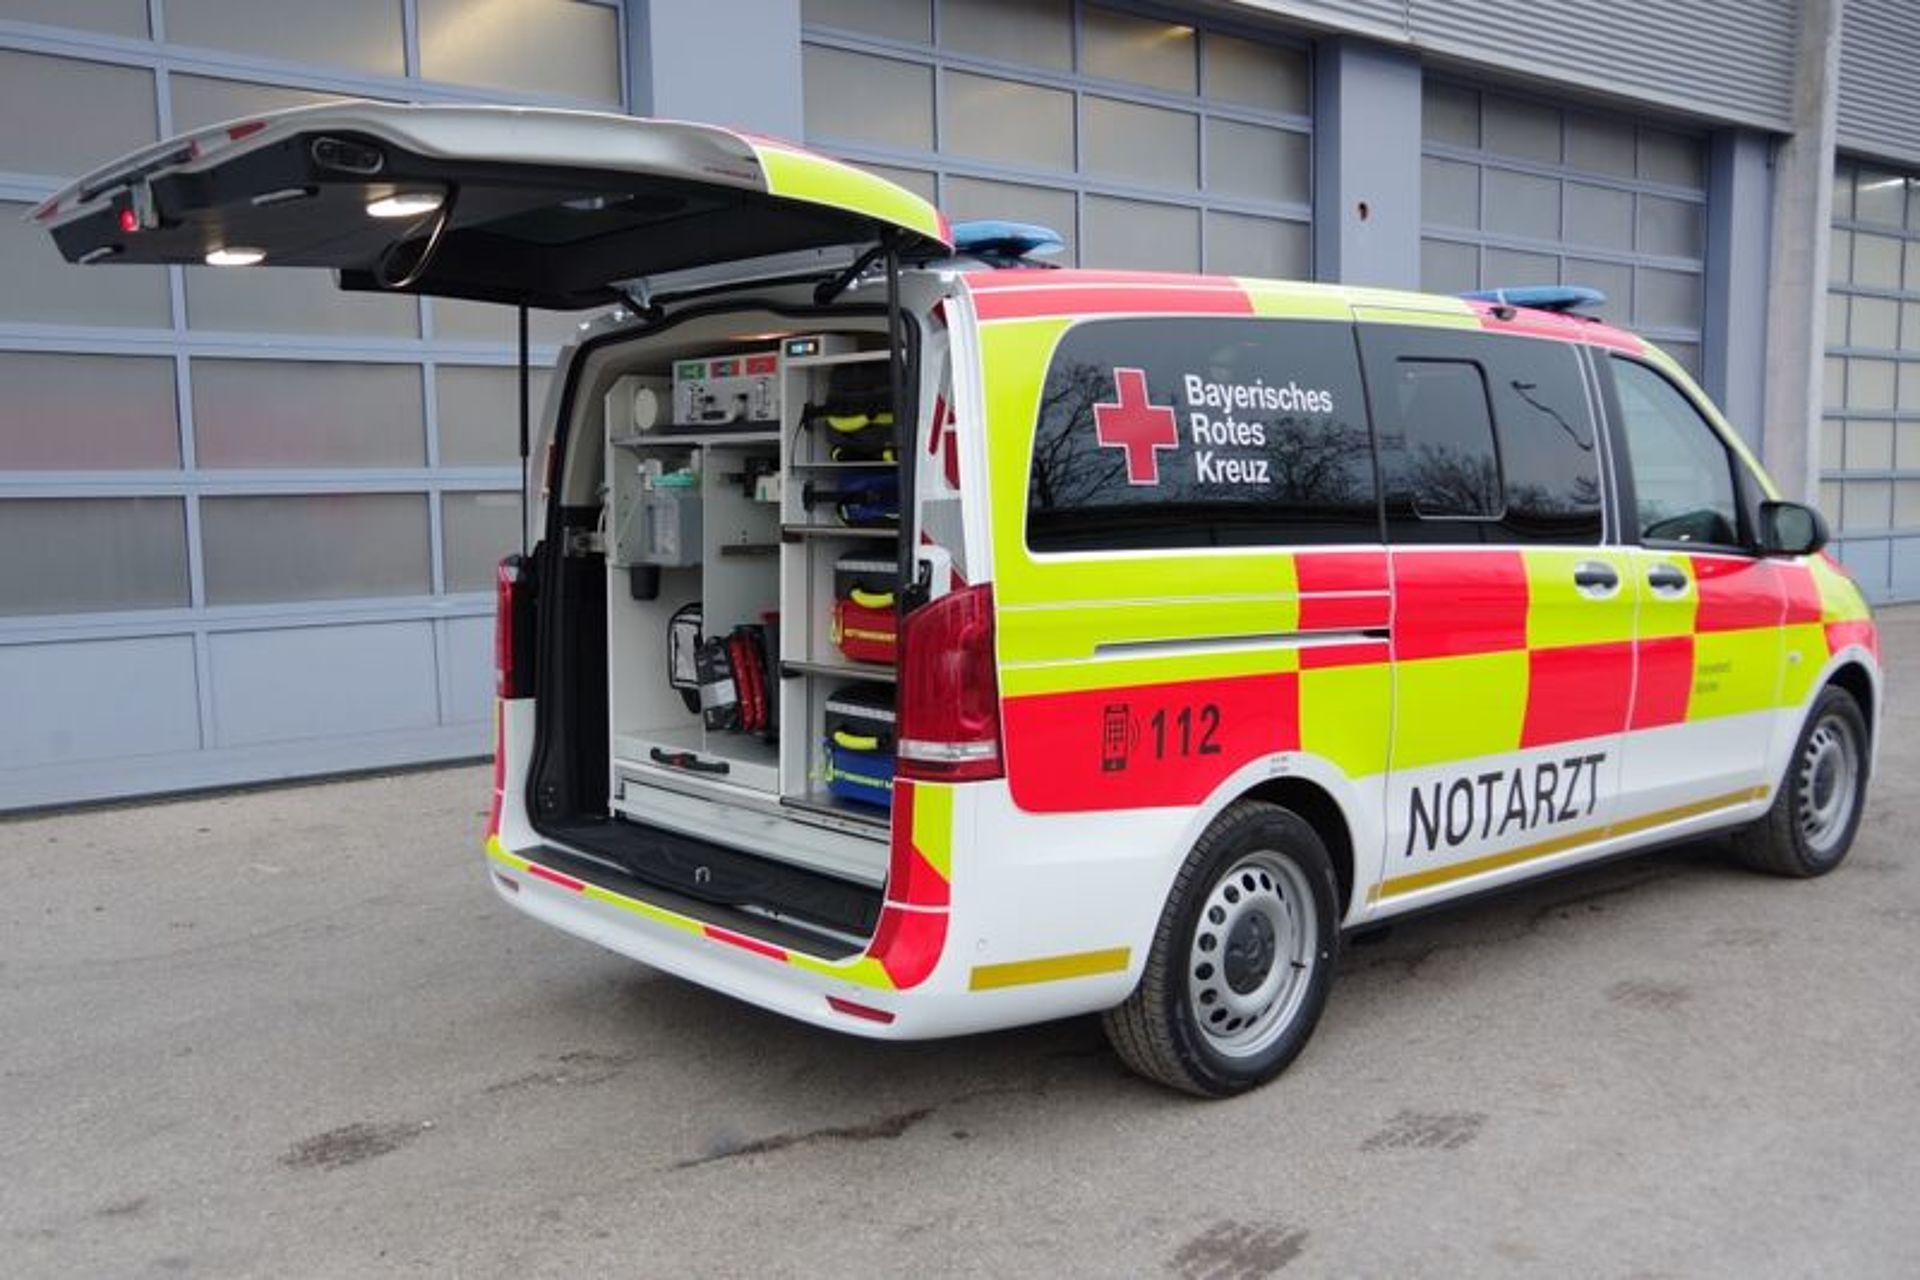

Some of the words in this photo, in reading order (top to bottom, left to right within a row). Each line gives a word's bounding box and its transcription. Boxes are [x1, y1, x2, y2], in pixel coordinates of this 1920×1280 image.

[1185, 374, 1333, 414] Bayerisches
[1190, 413, 1266, 446] Rotes
[1196, 451, 1271, 483] Kreuz
[1151, 703, 1222, 760] 112
[1405, 752, 1607, 858] NOTARZT
